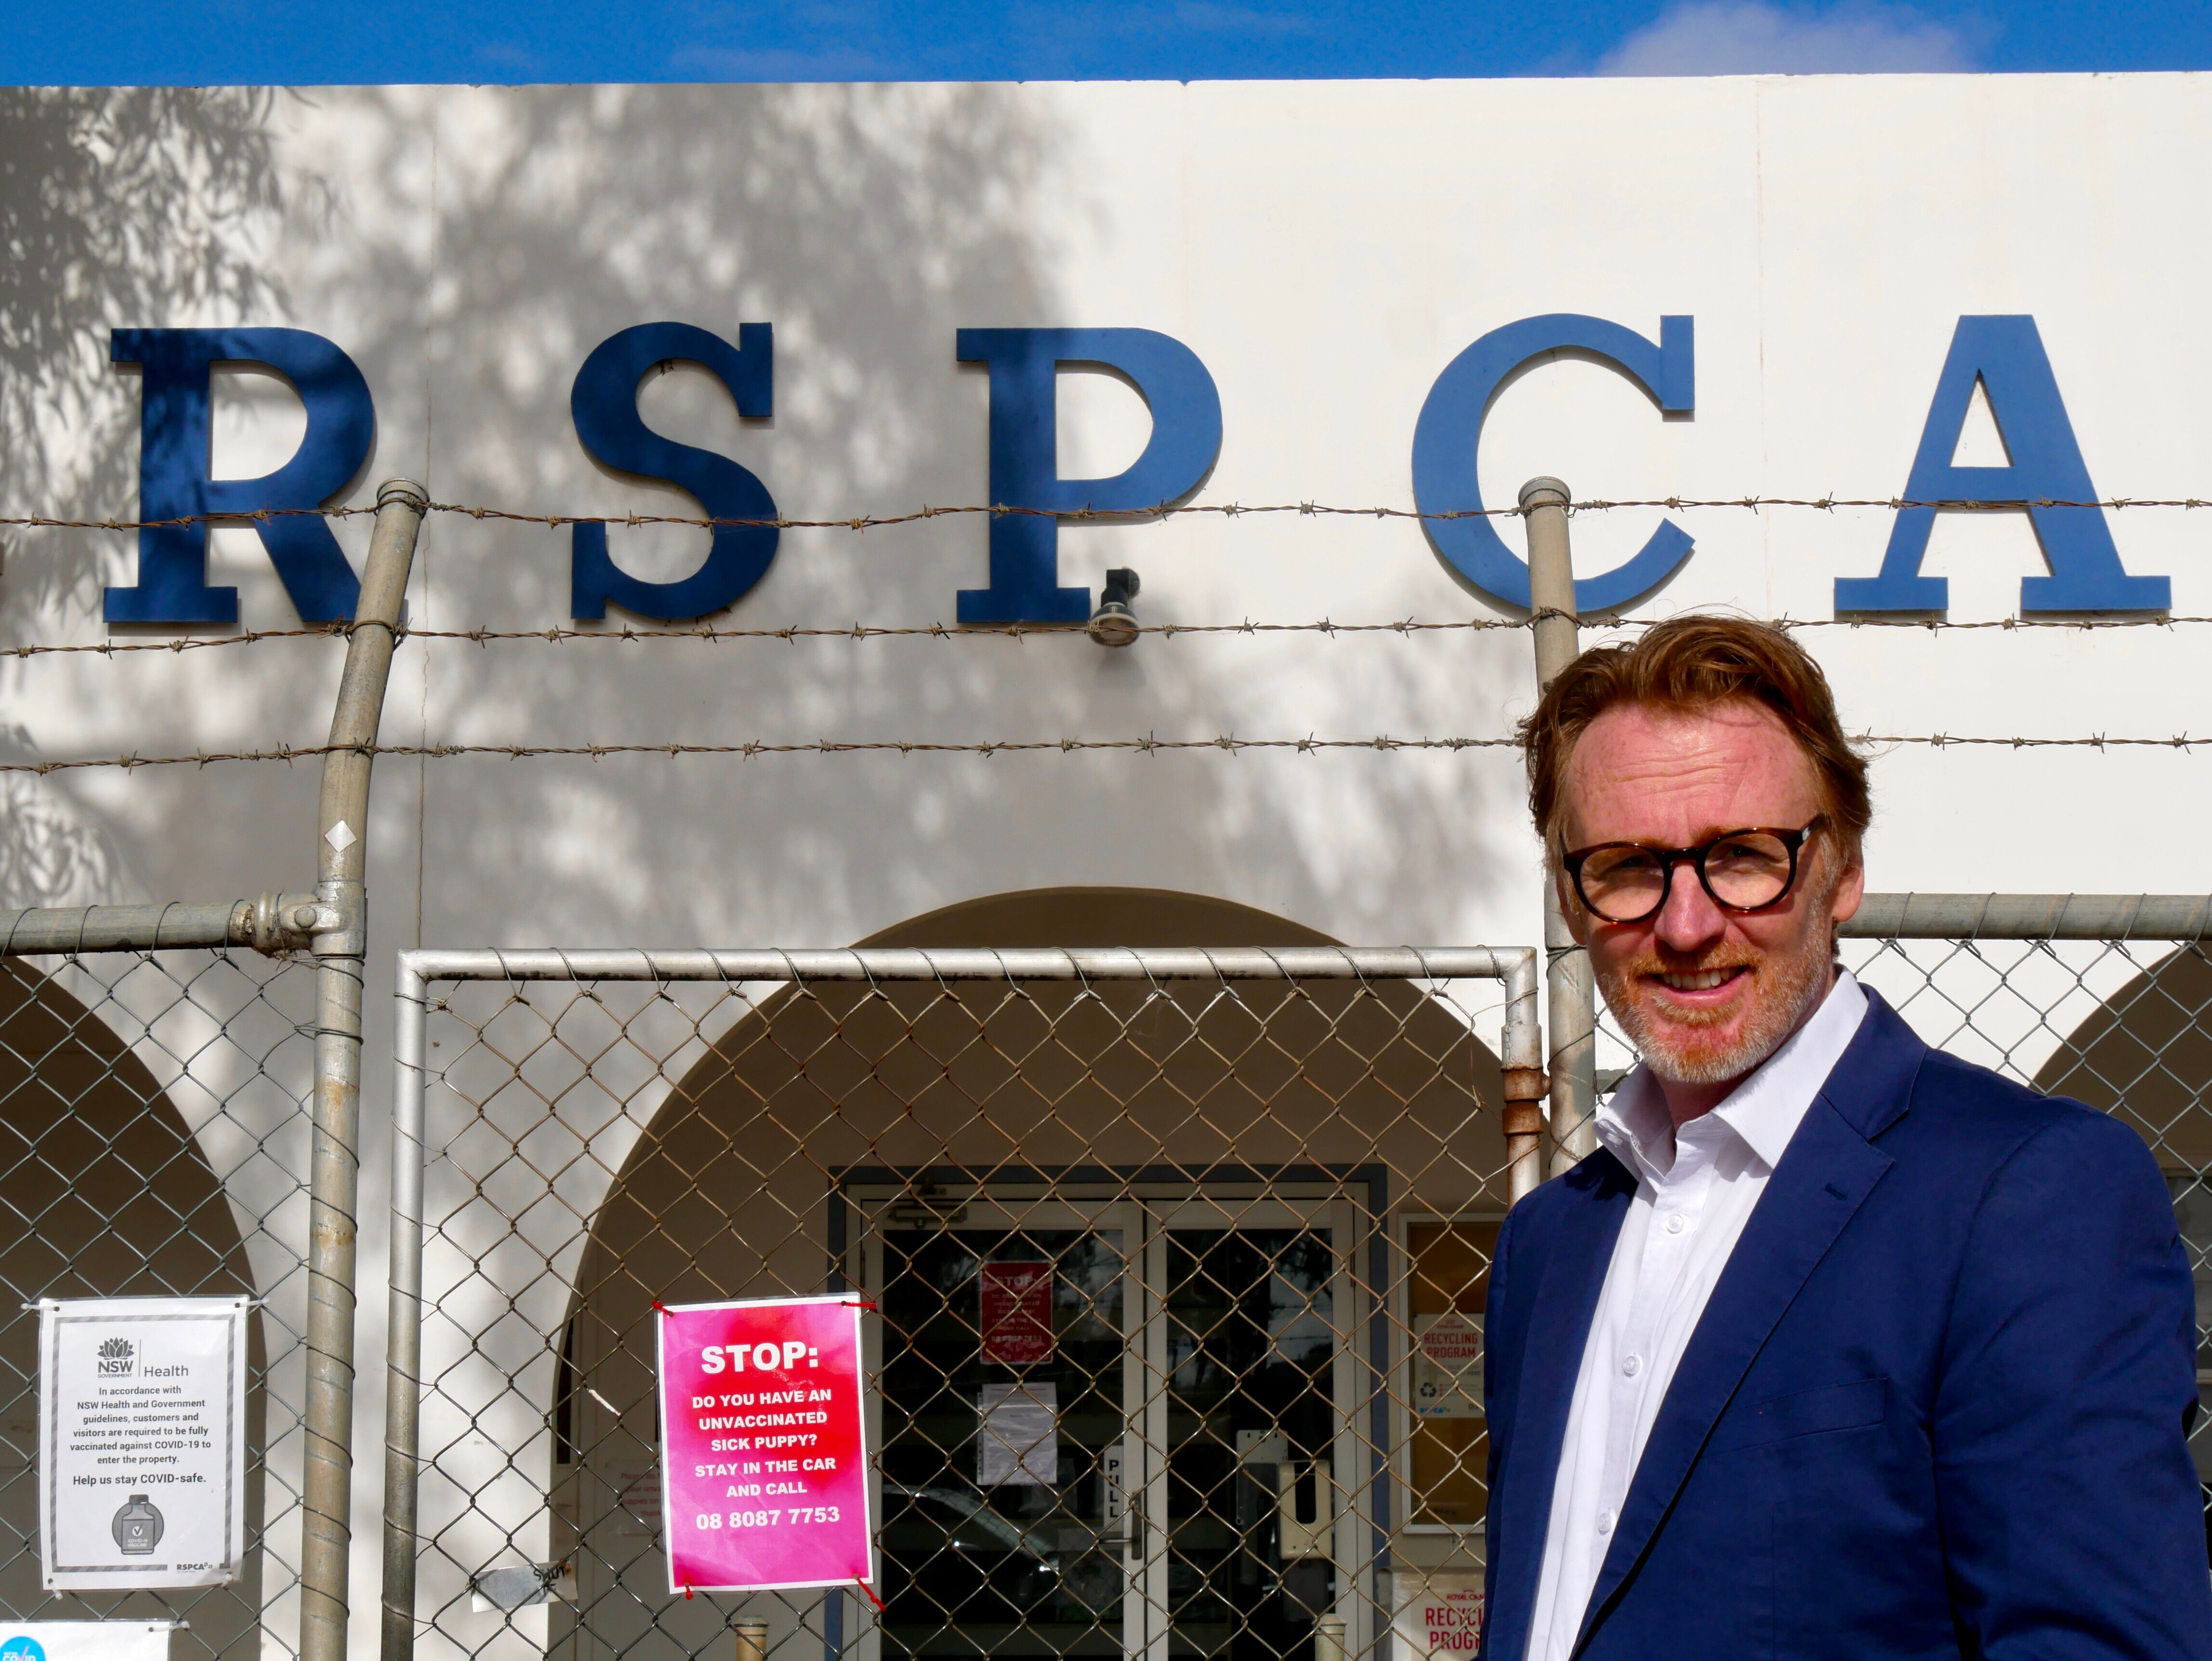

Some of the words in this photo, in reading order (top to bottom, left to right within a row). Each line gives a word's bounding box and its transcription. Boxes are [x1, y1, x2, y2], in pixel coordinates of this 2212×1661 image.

[103, 313, 2172, 623] RSPCA
[1424, 1333, 1478, 1345] RECYCLING
[701, 1341, 818, 1374] STOP:
[1426, 1347, 1476, 1358] PROGRAM
[98, 1360, 133, 1373] NSW
[145, 1365, 189, 1377] Health
[110, 1386, 160, 1395] accordance
[163, 1385, 182, 1394] with
[77, 1401, 99, 1410] NSW
[101, 1400, 130, 1409] Health
[132, 1400, 148, 1408] and
[151, 1399, 205, 1408] Government
[693, 1396, 715, 1409] DO
[721, 1393, 754, 1407] YOU
[760, 1390, 804, 1405] HAVE
[809, 1389, 831, 1402] AN
[83, 1414, 131, 1425] guidelines,
[133, 1414, 180, 1422] customers
[183, 1412, 198, 1421] and
[699, 1411, 827, 1430] UNVACCINATED
[73, 1428, 105, 1437] visitors
[125, 1427, 161, 1437] required
[189, 1426, 208, 1436] fully
[70, 1442, 117, 1450] vaccinated
[119, 1441, 152, 1451] against
[155, 1440, 199, 1449] COVID-19
[711, 1438, 750, 1452] SICK
[755, 1434, 817, 1450] PUPPY?
[139, 1455, 180, 1464] property.
[695, 1463, 737, 1477] STAY
[744, 1462, 760, 1474] IN
[765, 1459, 798, 1473] THE
[803, 1457, 836, 1471] CAR
[73, 1475, 96, 1487] Help
[115, 1475, 137, 1486] stay
[140, 1473, 206, 1483] COVID-safe.
[1109, 1460, 1119, 1517] PULL
[726, 1484, 761, 1498] AND
[766, 1481, 807, 1495] CALL
[696, 1513, 722, 1530] 08
[729, 1509, 781, 1529] 8087
[788, 1506, 840, 1524] 7753
